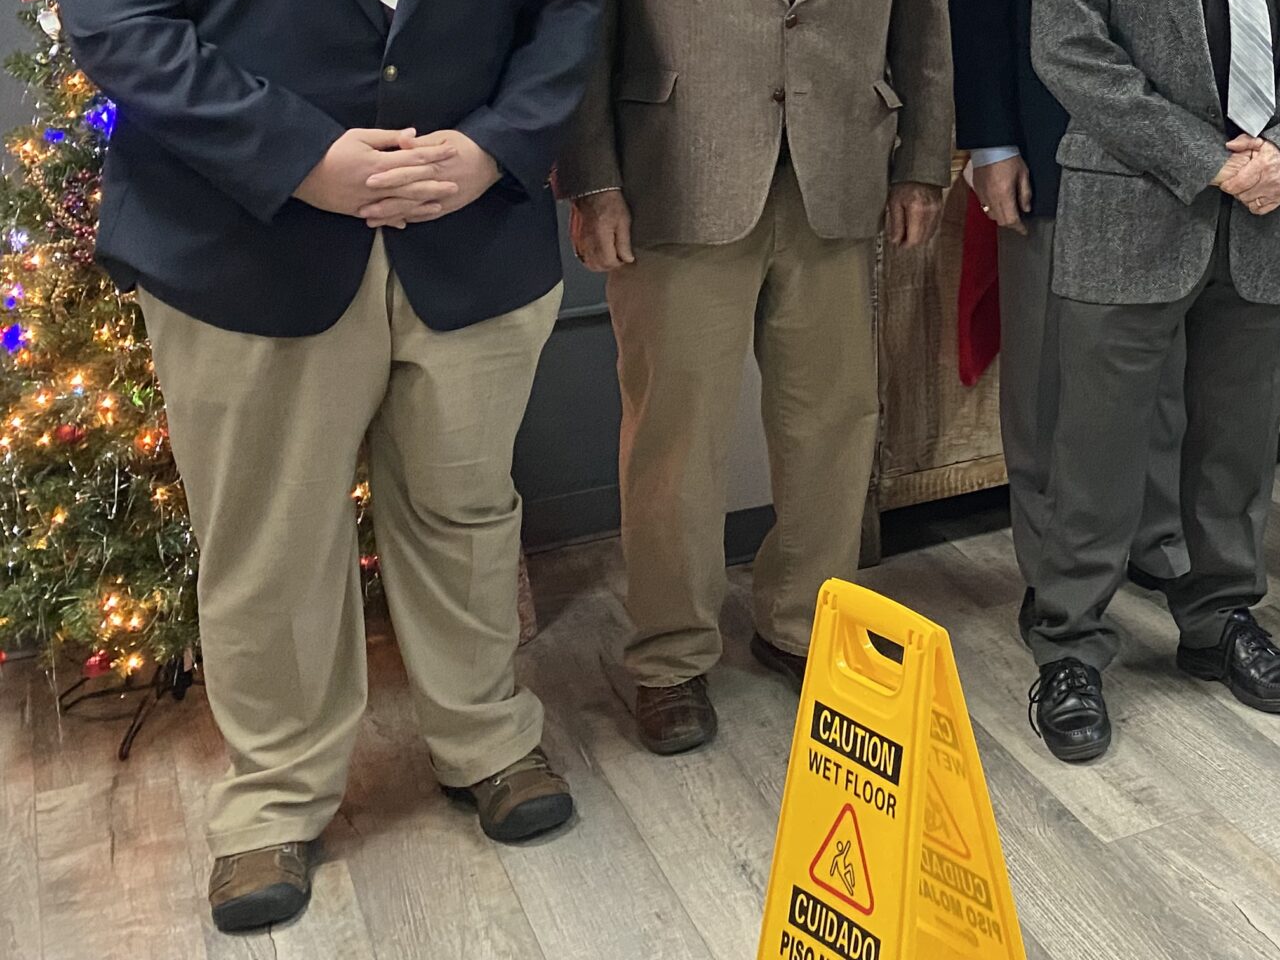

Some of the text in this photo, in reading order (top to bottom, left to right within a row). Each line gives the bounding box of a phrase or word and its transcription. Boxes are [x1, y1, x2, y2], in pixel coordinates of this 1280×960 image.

[819, 709, 895, 776] CAUTION
[809, 748, 897, 820] WET FLOOR
[795, 893, 876, 960] CUIDADO
